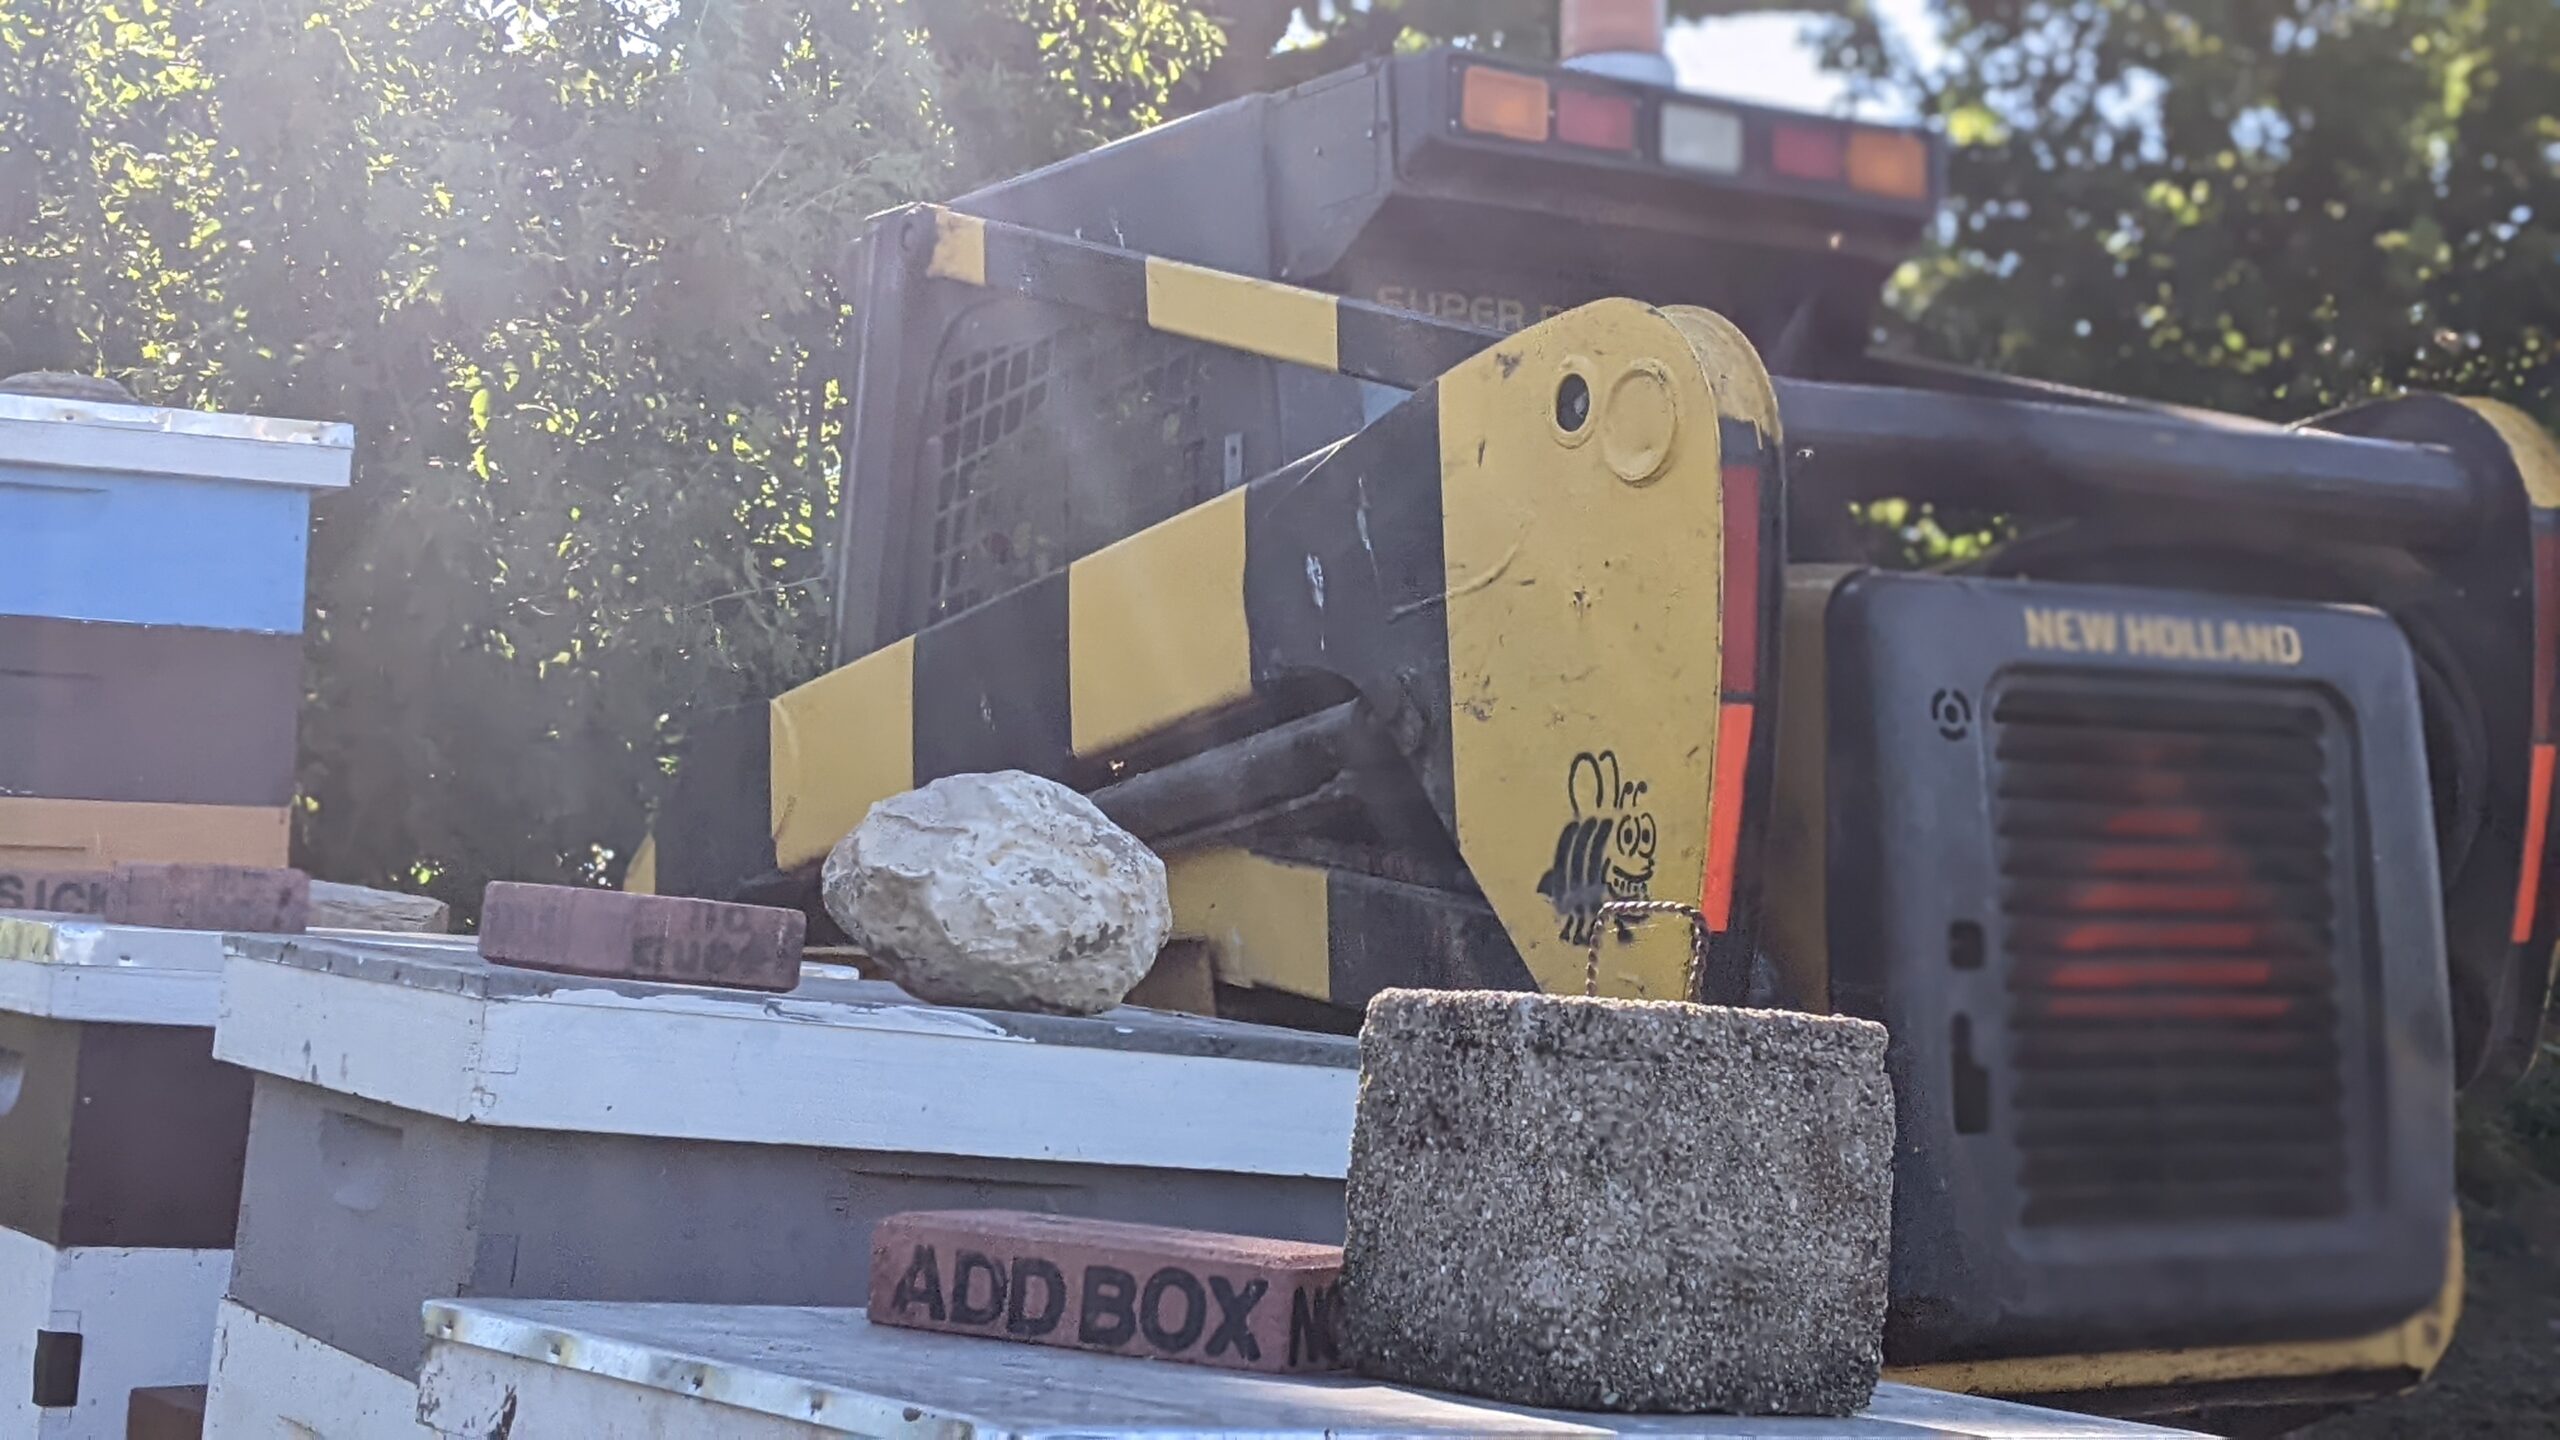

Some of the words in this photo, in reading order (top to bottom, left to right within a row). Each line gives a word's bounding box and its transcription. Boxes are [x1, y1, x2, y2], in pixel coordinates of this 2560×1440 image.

[1376, 285, 1527, 333] SUPER
[2023, 606, 2118, 655] NEW
[2123, 613, 2304, 666] HOLLAND
[892, 1244, 1068, 1337] ADD
[1077, 1264, 1269, 1363] BOX
